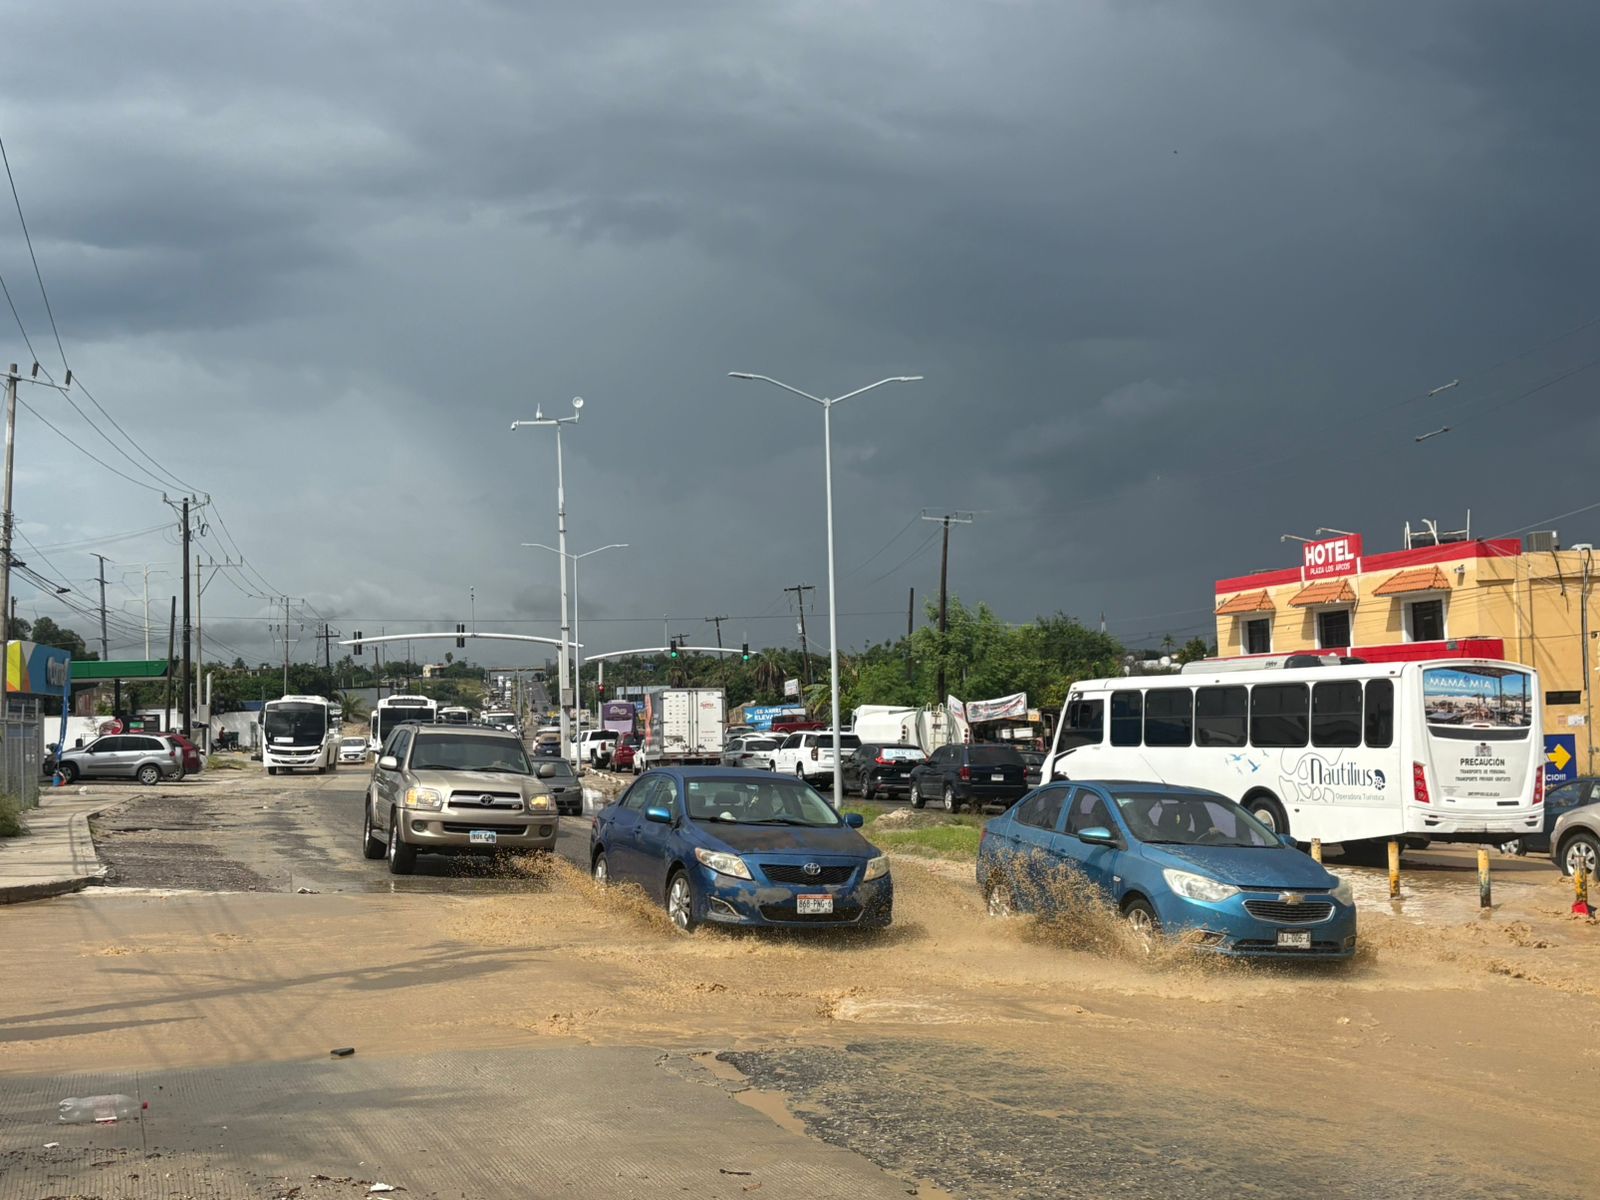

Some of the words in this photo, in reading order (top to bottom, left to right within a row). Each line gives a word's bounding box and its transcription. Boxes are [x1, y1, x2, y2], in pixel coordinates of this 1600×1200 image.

[1305, 539, 1354, 567] HOTEL
[1310, 567, 1325, 575] PLAZA
[1325, 565, 1334, 573] LOS
[1335, 562, 1350, 571] ARCOS
[1460, 757, 1505, 767] PRECAUCIÓN
[1336, 792, 1361, 801] Operadora
